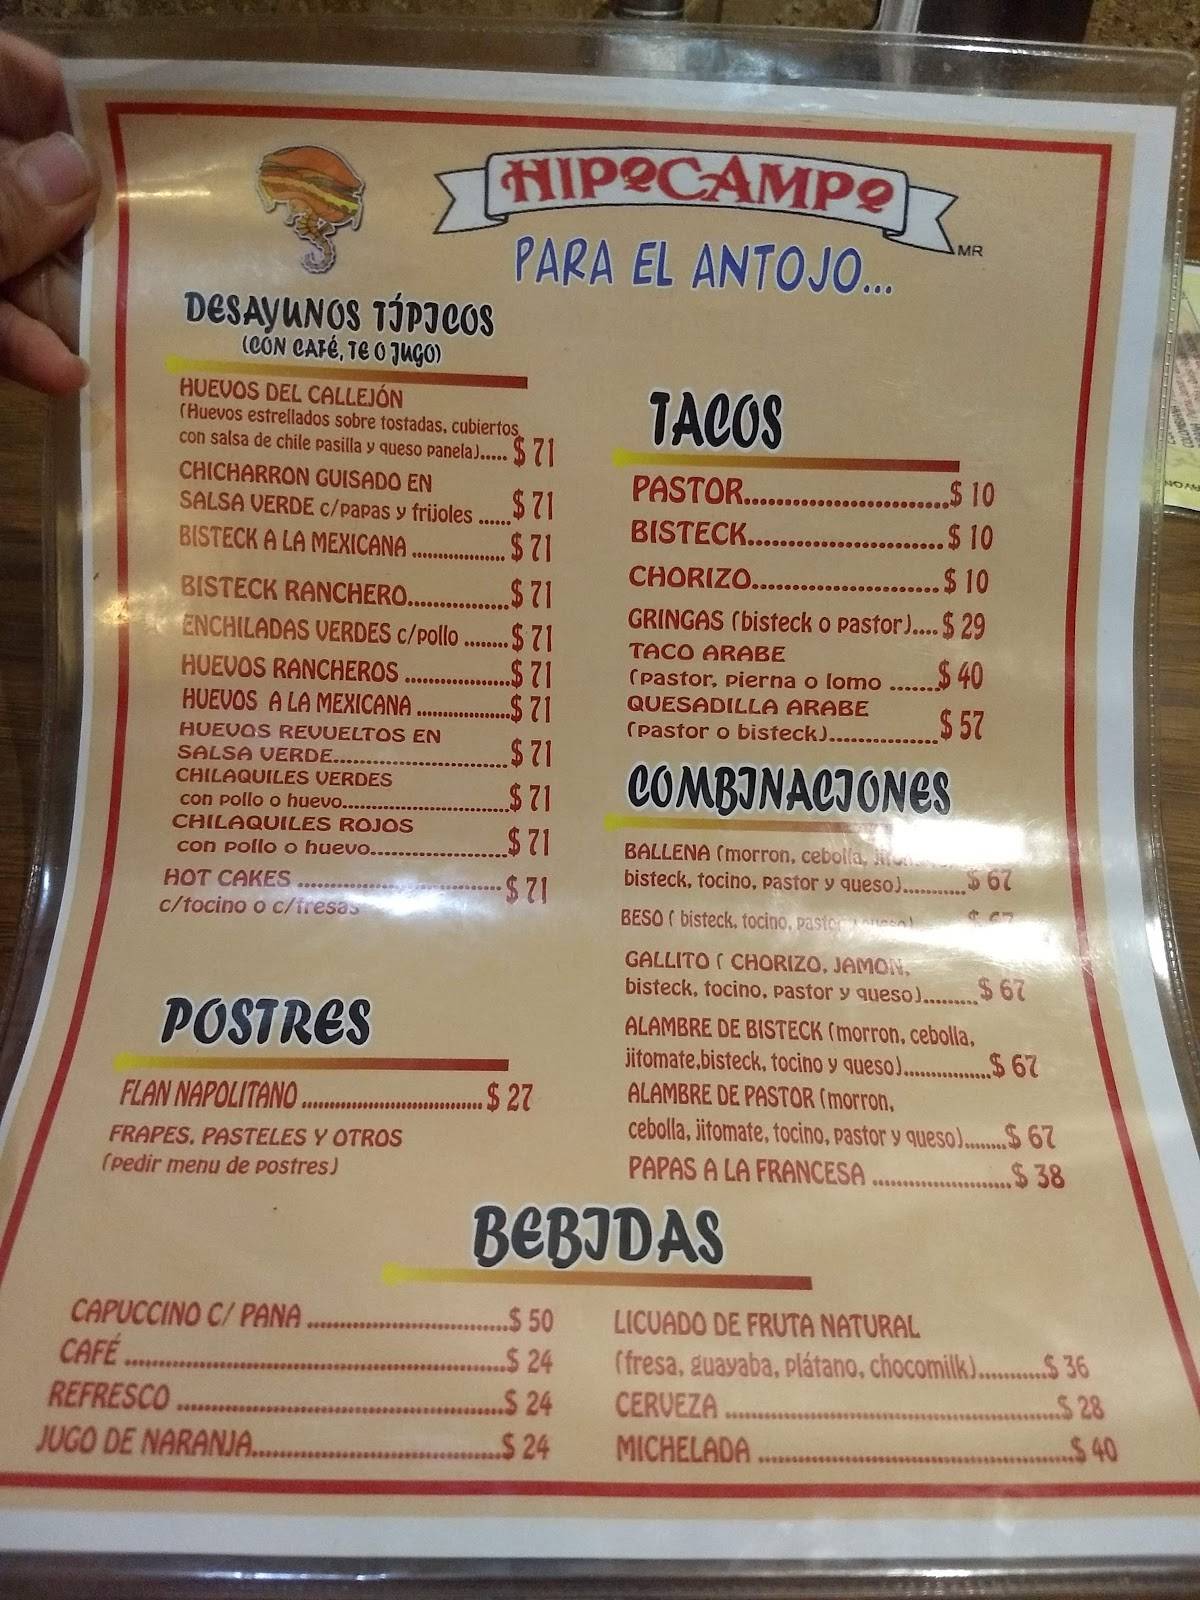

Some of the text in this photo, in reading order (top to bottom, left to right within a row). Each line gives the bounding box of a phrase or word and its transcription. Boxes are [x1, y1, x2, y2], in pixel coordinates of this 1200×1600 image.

[517, 236, 612, 285] PARA
[633, 241, 672, 286] EL
[958, 244, 983, 257] MR
[184, 292, 494, 336] DESAYUNOS TÍPICOS
[348, 341, 369, 360] TE
[180, 377, 403, 408] HUEVOS DEL CALLEJÓN
[248, 408, 330, 427] estrellados
[335, 413, 376, 429] sobre
[650, 392, 781, 449] TACOS
[179, 431, 422, 456] con salsa de chile pasilla queso
[179, 460, 432, 493] CHICHARRON GUISADO EN
[180, 490, 244, 512] SALSA
[251, 494, 314, 516] VERDE
[412, 503, 472, 524] frijoles
[180, 525, 406, 557] BISTECK LA MEXICANA
[182, 575, 277, 600] BISTECK
[183, 614, 309, 640] ENCHILADAS
[316, 620, 391, 644] VERDES
[628, 608, 724, 631] GRINGAS
[629, 642, 786, 662] TACO ARABE
[182, 654, 398, 683] HUEVOS RANCHEROS
[726, 675, 795, 688] pierna
[827, 673, 881, 690] lomo
[183, 688, 411, 716] HUEVOS LA MEXICANA
[627, 695, 869, 717] QUESADILLA ARABE
[180, 722, 440, 743] HUEVOS REVUELTOS EN
[177, 745, 252, 760] SALSA
[176, 768, 392, 787] CHILAQUILES VERDES
[180, 792, 264, 807] con pollo
[628, 765, 950, 816] COMBINACIONES
[172, 814, 413, 833] CHILAQUILES ROJOS
[177, 839, 277, 853] con pollo
[625, 843, 710, 861] BALLENA
[164, 868, 290, 887] HOT CAKES
[763, 875, 819, 891] pastor
[621, 909, 663, 927] BESO
[625, 951, 709, 969] GALLITO
[774, 984, 833, 1000] pastor
[161, 998, 370, 1045] POSTRES
[625, 1016, 712, 1037] ALAMBRE
[718, 1018, 740, 1038] DE
[746, 1019, 823, 1041] BISTECK
[771, 1052, 823, 1073] tocino
[120, 1079, 297, 1109] FLAN NAPOLITANO
[628, 1082, 712, 1105] ALAMBRE
[717, 1084, 740, 1106] DE
[745, 1085, 815, 1108] PASTOR
[202, 1127, 307, 1146] PASTELES
[333, 1129, 402, 1147] OTROS
[834, 1125, 886, 1146] pastor
[166, 1158, 220, 1174] menu
[226, 1156, 250, 1174] de
[629, 1156, 865, 1185] PAPAS LA FRANCESA
[474, 1205, 723, 1268] BEBIDAS
[71, 1298, 201, 1327] CAPUCCINO
[240, 1303, 301, 1328] PANA
[615, 1310, 921, 1338] LICUADO DE FRUTA NATURAL
[60, 1333, 121, 1365] CAFÉ
[47, 1380, 170, 1411] REFRESCO
[615, 1391, 717, 1418] CERVEZA
[35, 1425, 96, 1454] JUGO
[104, 1427, 136, 1455] DE
[616, 1435, 750, 1463] MICHELADA
